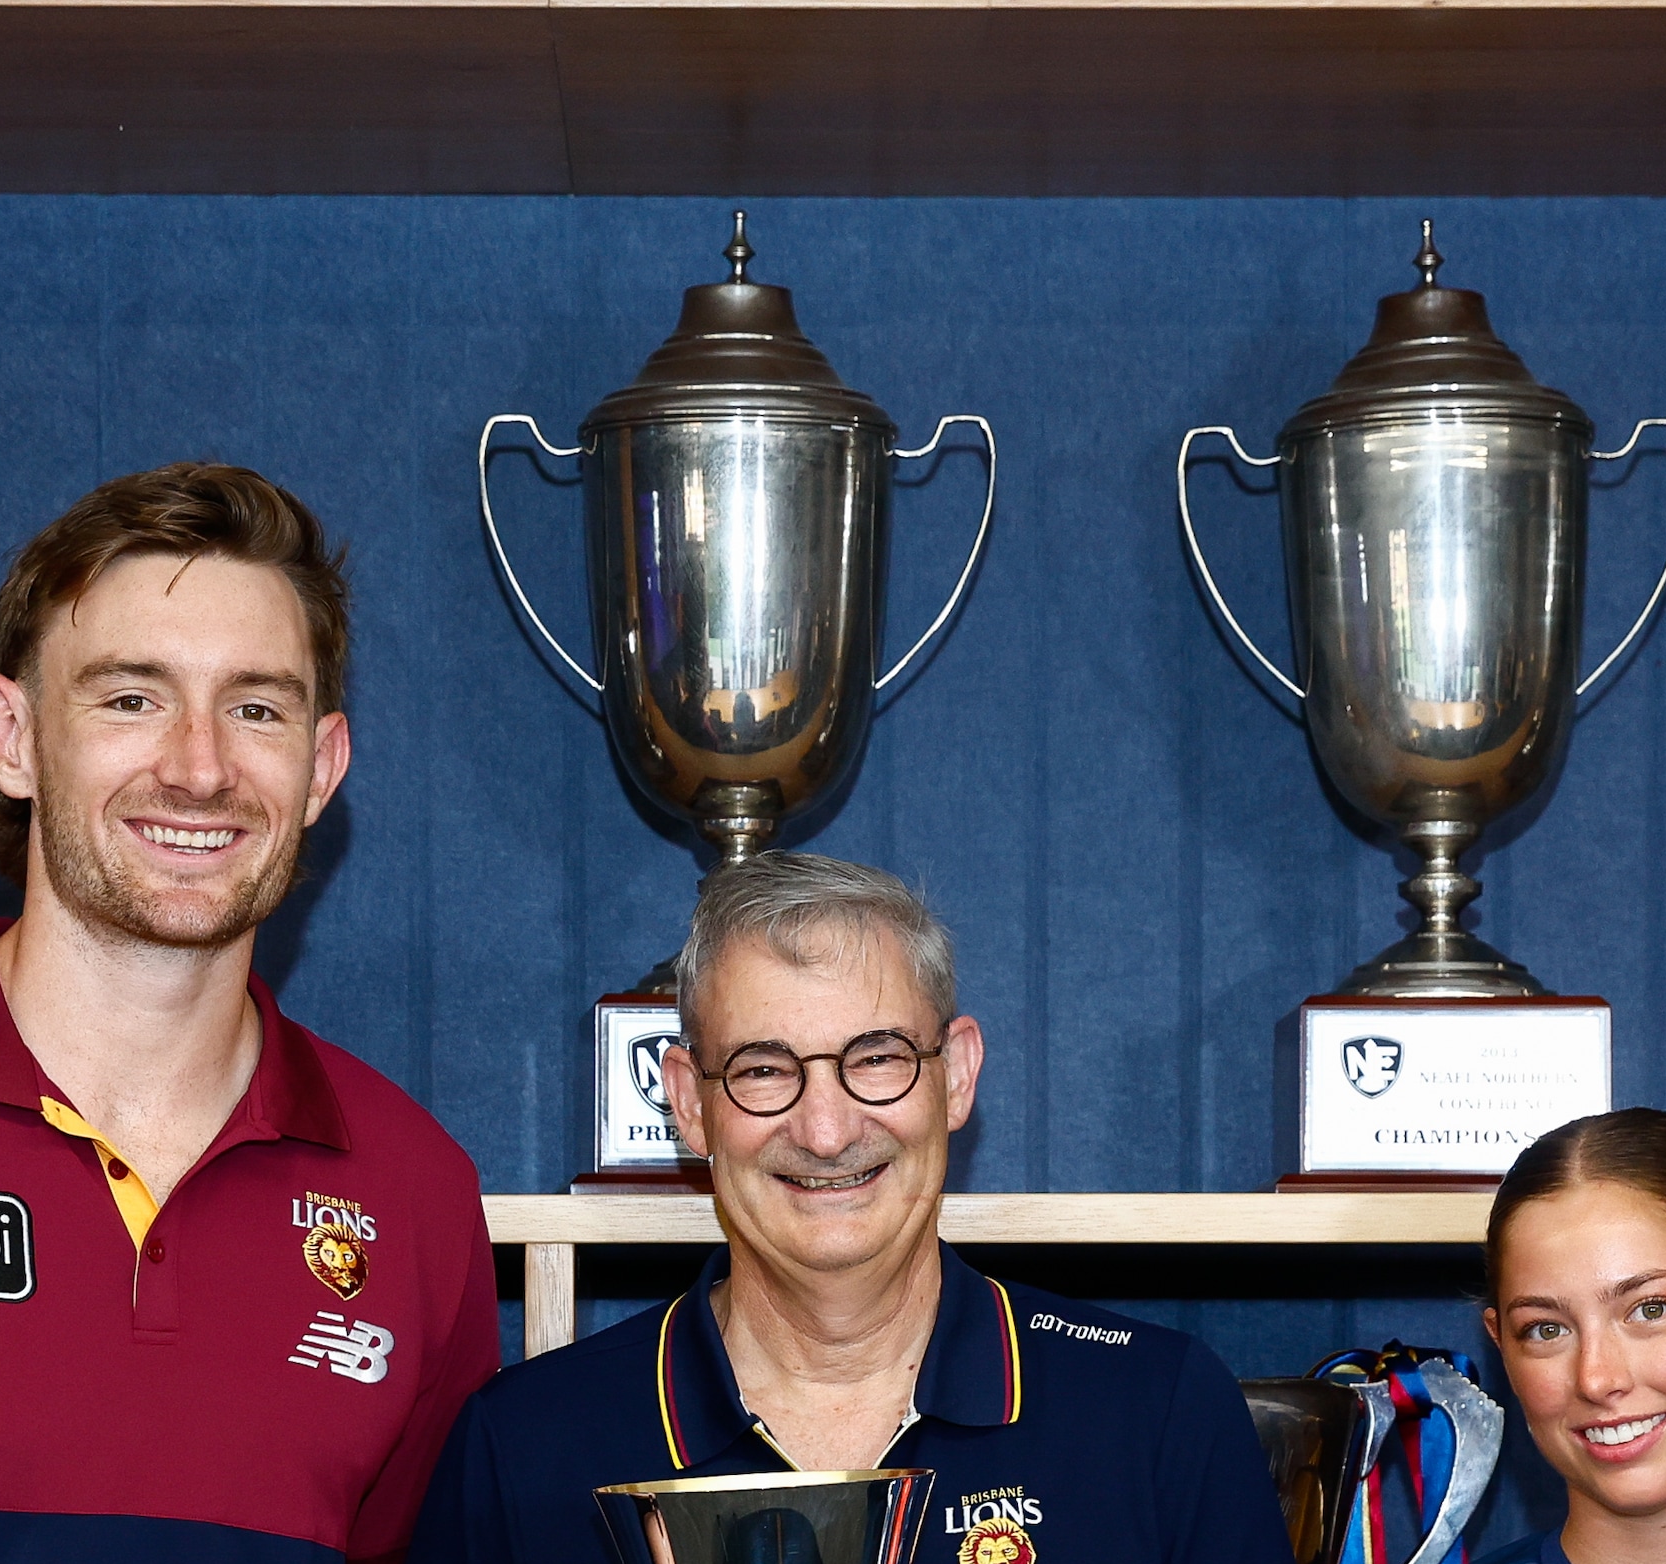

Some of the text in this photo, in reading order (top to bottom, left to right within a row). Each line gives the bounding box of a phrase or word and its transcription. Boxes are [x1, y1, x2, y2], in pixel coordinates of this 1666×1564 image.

[1374, 1128, 1538, 1145] CHAMPIONS
[305, 1190, 362, 1214] BRISBANE
[291, 1198, 378, 1242] LIONS
[961, 1486, 1025, 1506] BRISBANE
[945, 1497, 1043, 1534] LIONS
